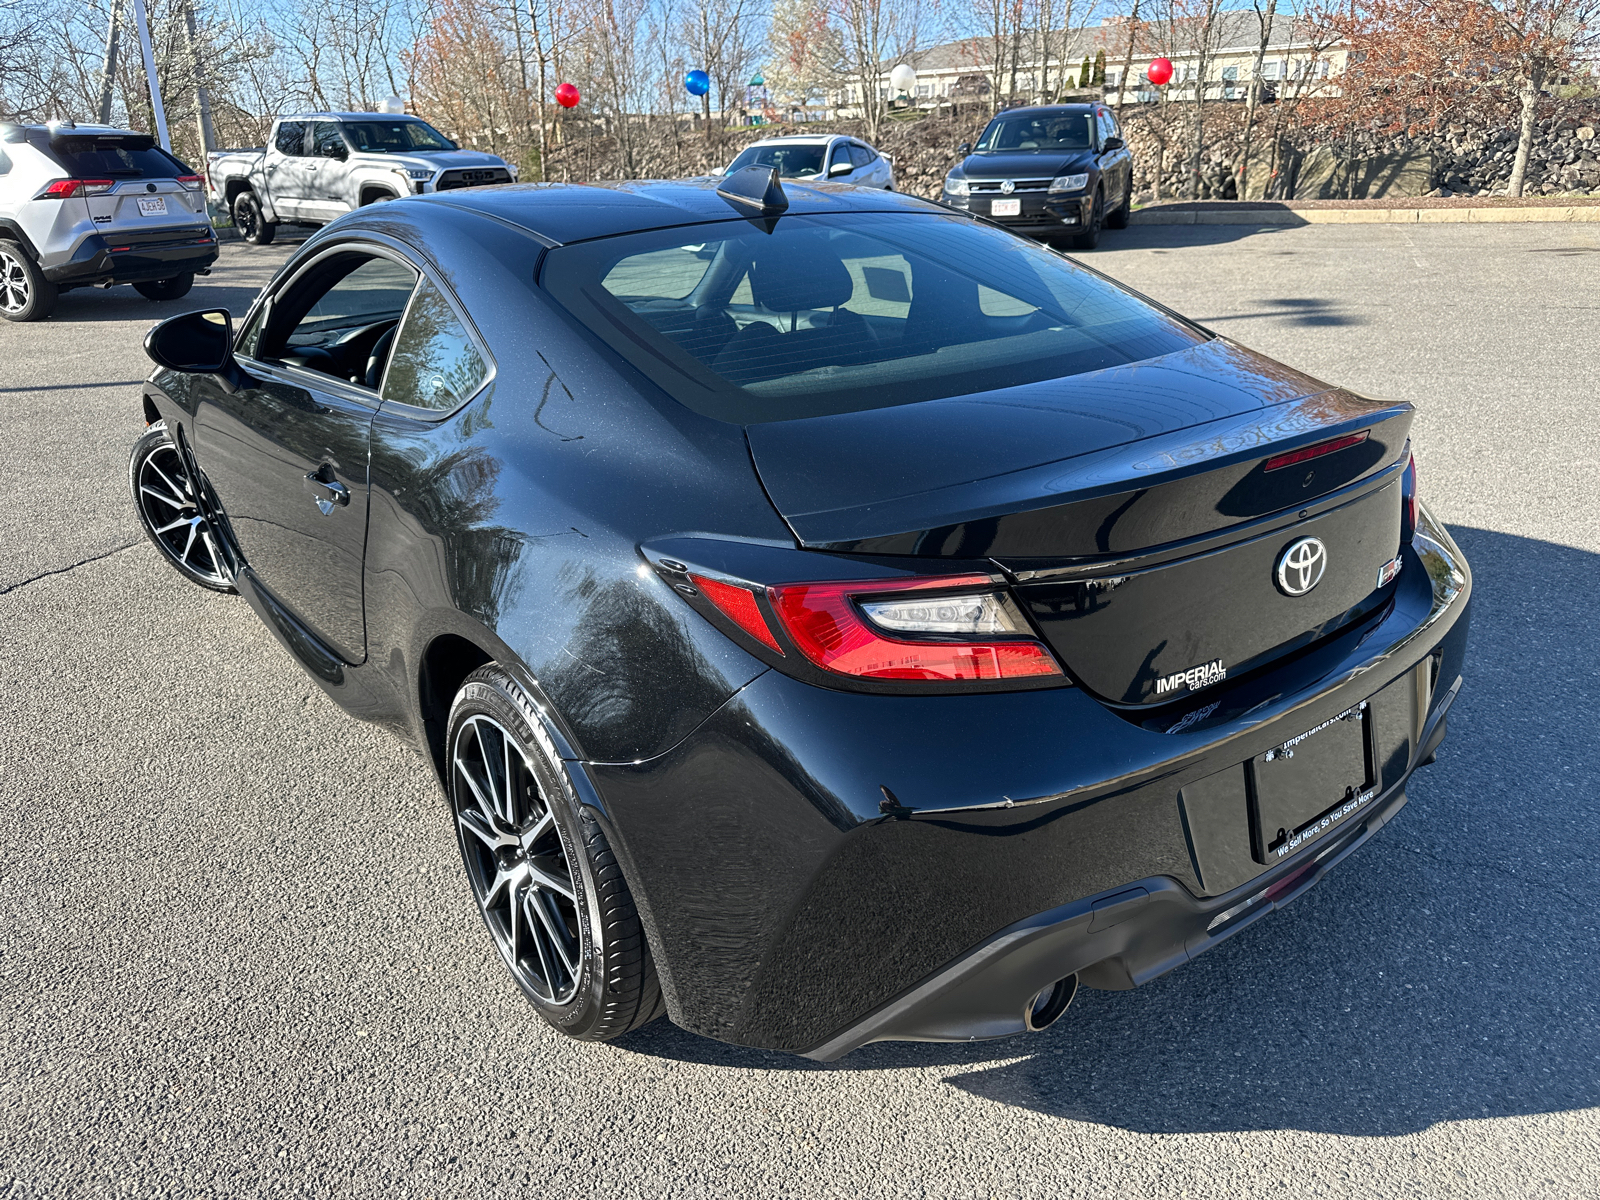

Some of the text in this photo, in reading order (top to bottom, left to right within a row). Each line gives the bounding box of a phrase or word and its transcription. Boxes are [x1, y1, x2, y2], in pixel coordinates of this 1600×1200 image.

[1157, 659, 1227, 694] IMPERIAL
[1189, 671, 1227, 691] cars.com
[1277, 791, 1374, 857] We Sell More, So You Save More
